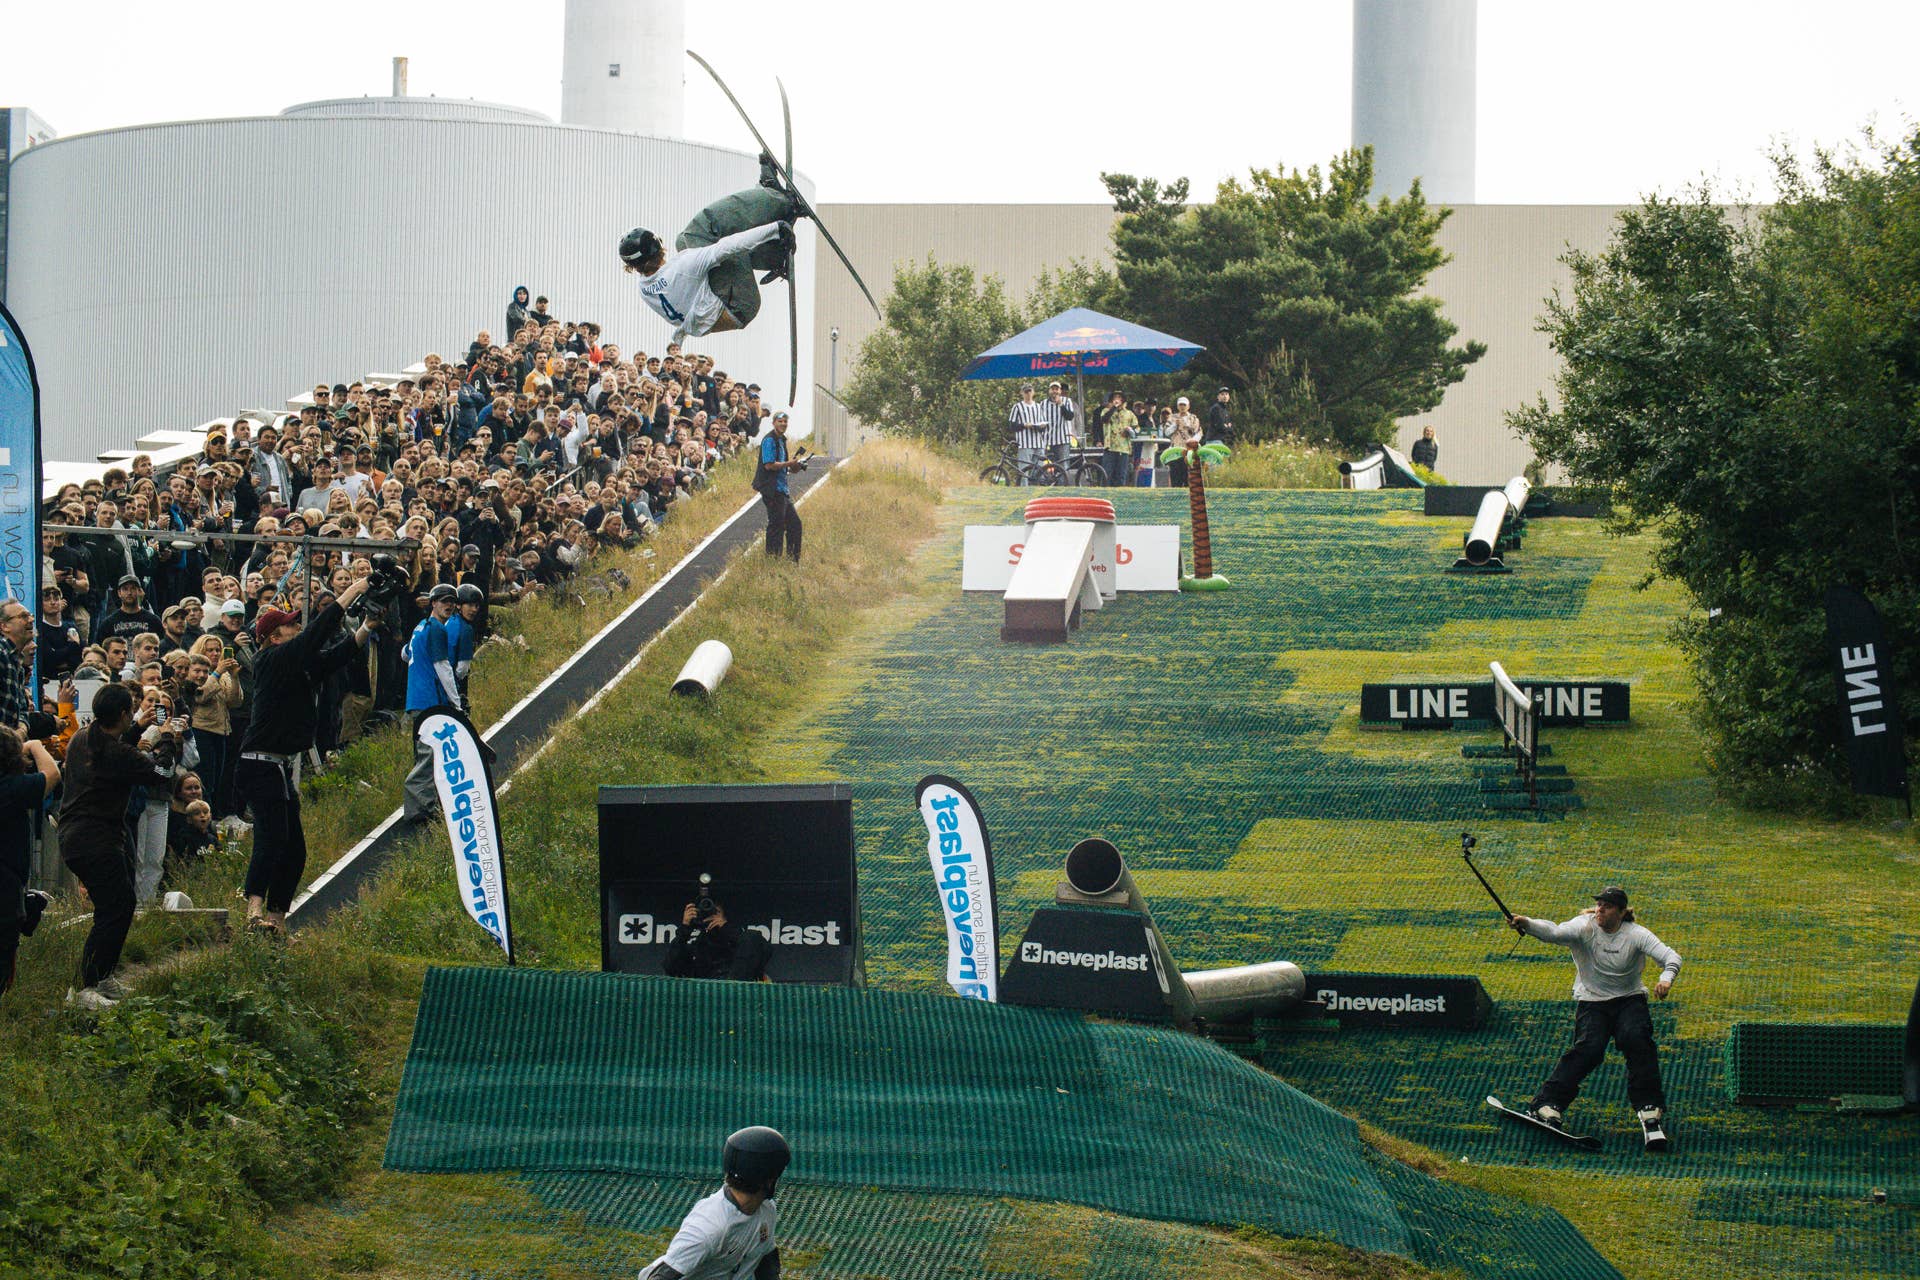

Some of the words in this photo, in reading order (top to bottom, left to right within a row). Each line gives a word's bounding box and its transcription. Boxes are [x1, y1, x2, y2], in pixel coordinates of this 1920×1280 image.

[1089, 335, 1128, 346] Bull
[1389, 688, 1469, 719] LINE
[1042, 950, 1149, 971] neveplast
[1339, 993, 1446, 1016] neveplast
